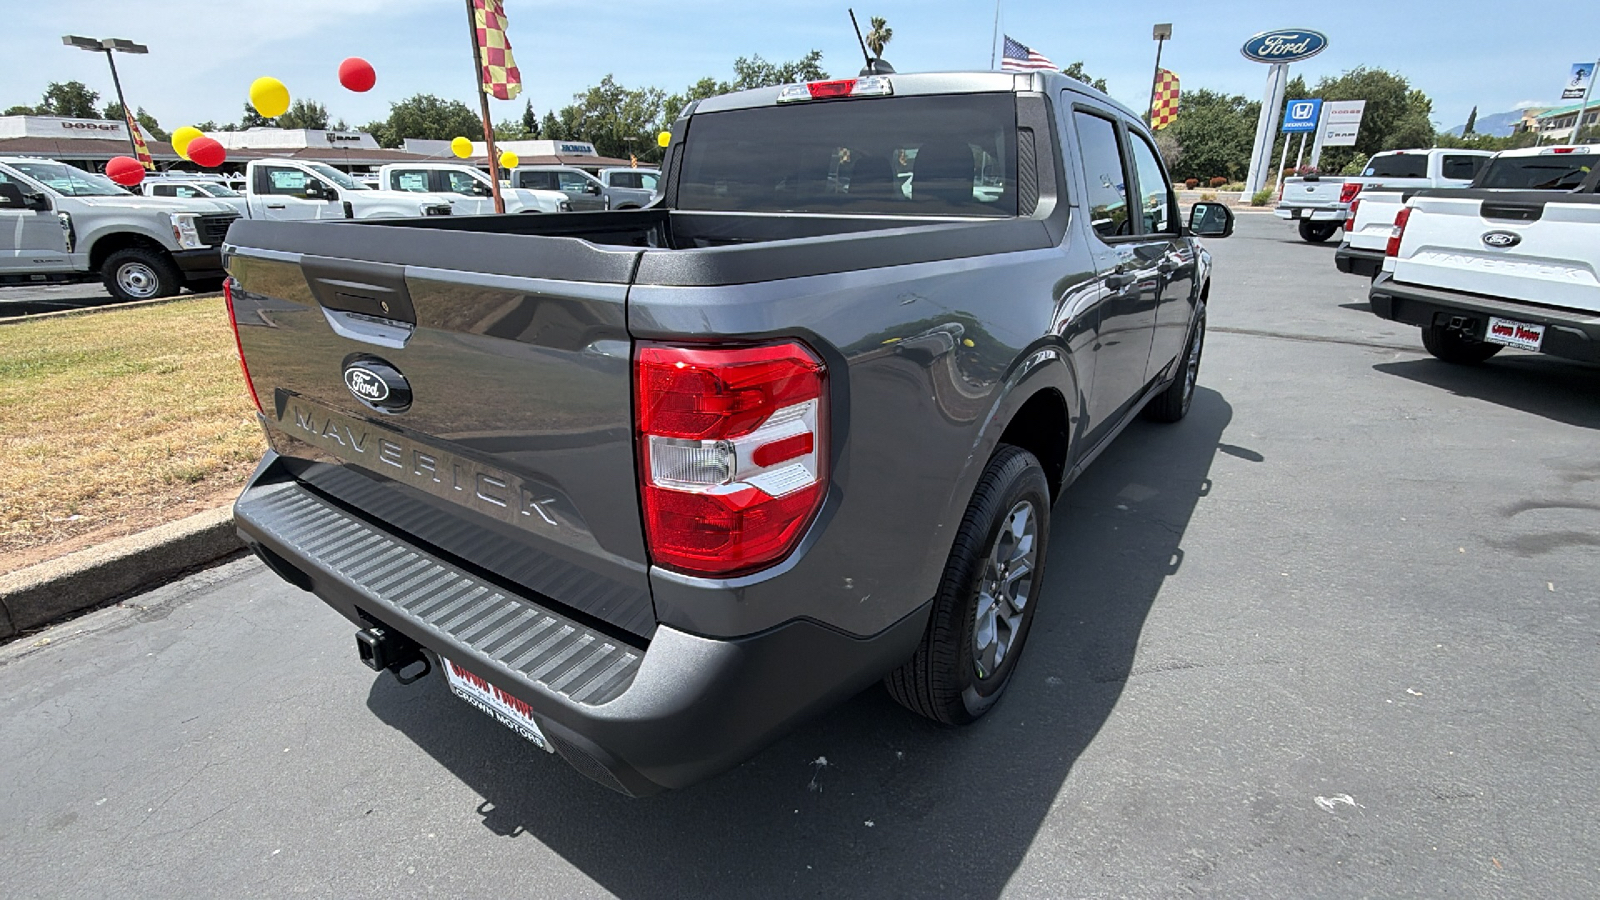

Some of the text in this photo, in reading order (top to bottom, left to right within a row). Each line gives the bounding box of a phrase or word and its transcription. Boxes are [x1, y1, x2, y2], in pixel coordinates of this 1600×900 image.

[1258, 34, 1311, 55] Ford
[62, 122, 120, 131] DODGE
[1423, 252, 1578, 278] MAVERICK
[353, 371, 379, 397] Ford
[294, 405, 558, 526] MAVERICK
[455, 687, 495, 718] CROWN
[495, 712, 545, 749] MOTORS
